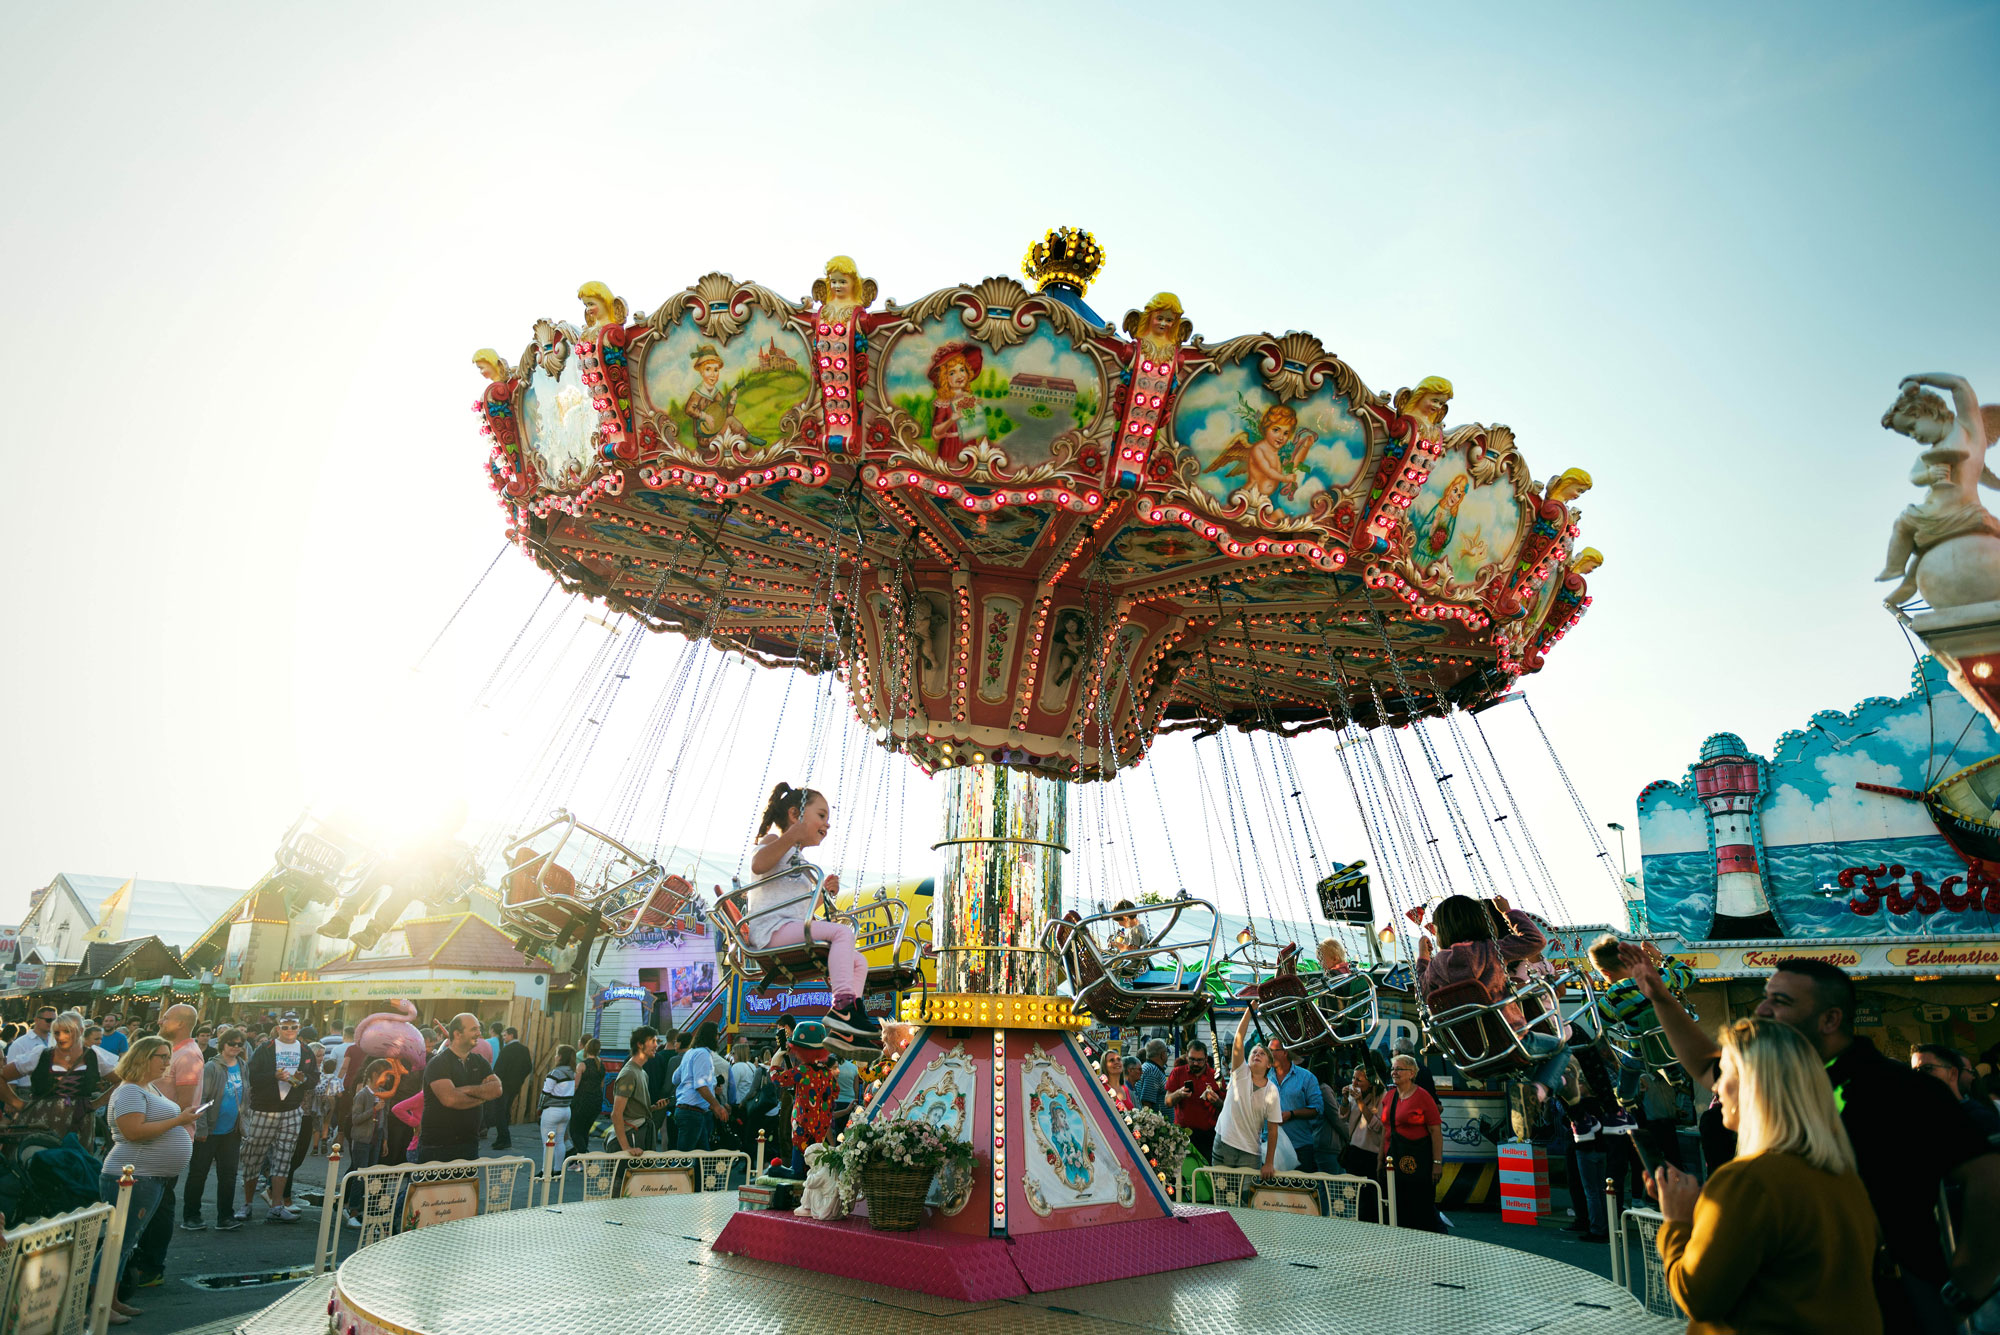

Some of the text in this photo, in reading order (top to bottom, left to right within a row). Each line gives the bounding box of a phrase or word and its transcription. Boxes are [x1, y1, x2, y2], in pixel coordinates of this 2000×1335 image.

[1838, 863, 2000, 916] Fisch
[1905, 948, 1999, 966] Edelmatjes
[1382, 1003, 1398, 1014] 21
[1502, 1147, 1528, 1157] Hellberg
[640, 1184, 678, 1194] Eltern haften
[1505, 1199, 1532, 1210] Hellberg
